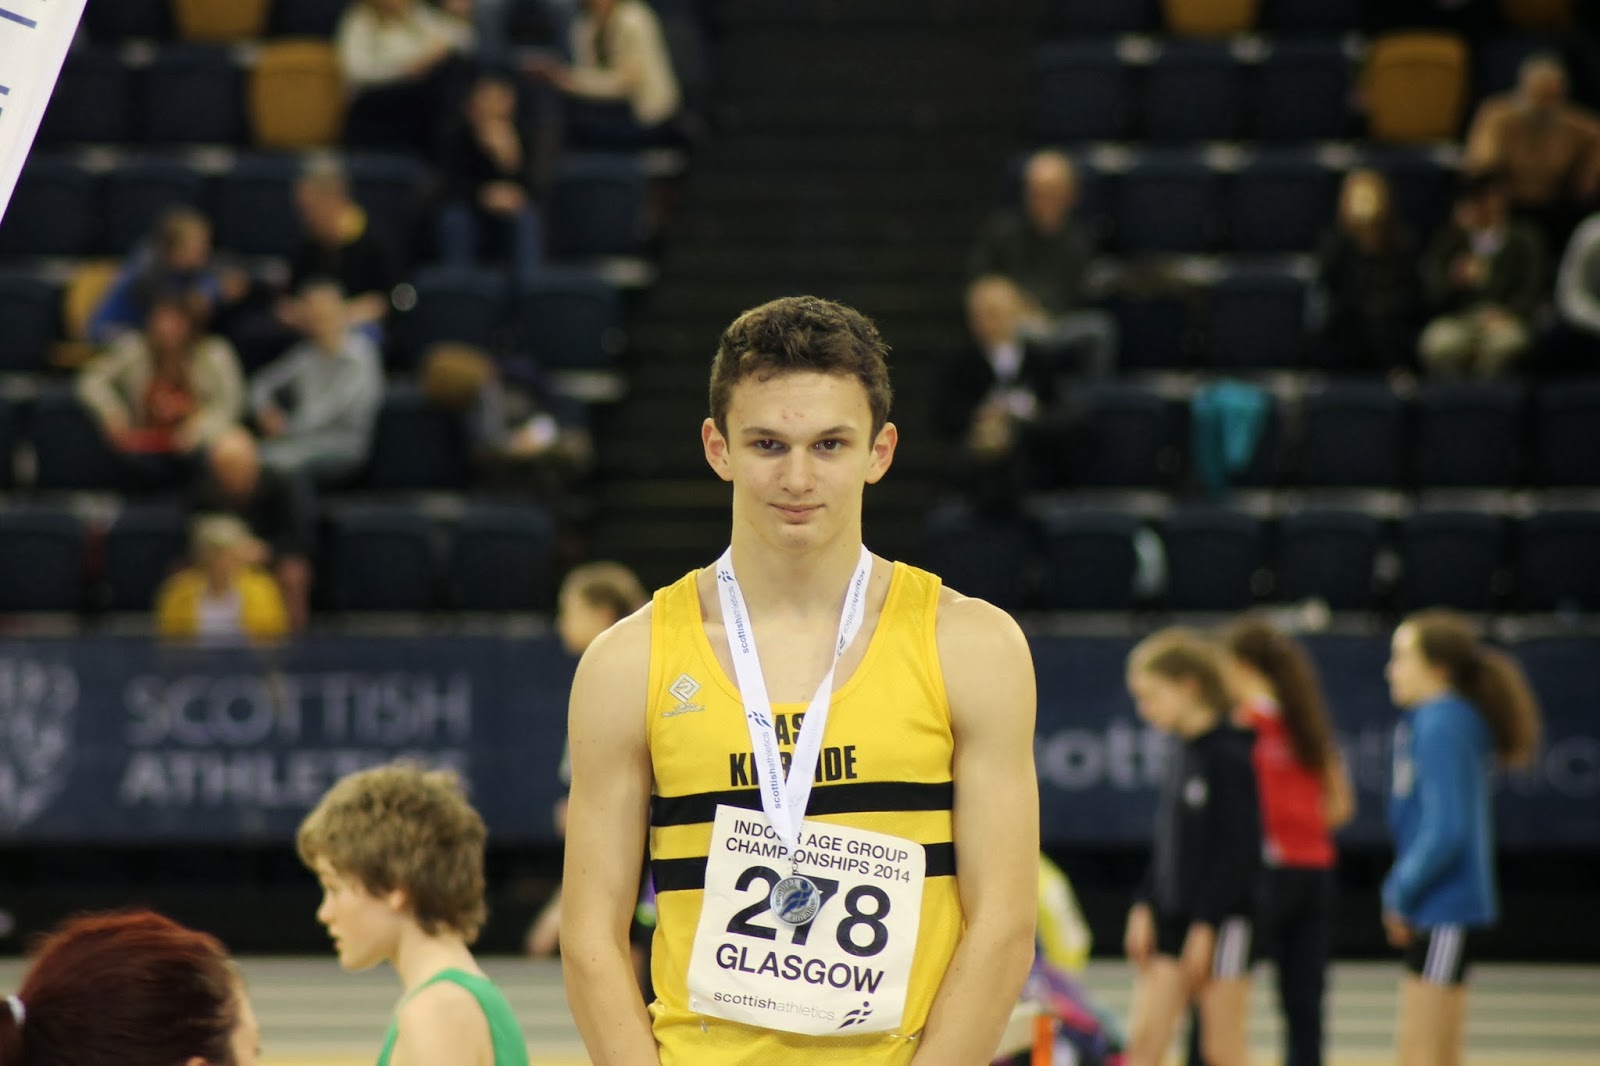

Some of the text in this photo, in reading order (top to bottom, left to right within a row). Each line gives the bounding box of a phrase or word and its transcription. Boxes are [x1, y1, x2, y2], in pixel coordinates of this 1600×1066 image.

[762, 731, 782, 809] scottishathletics
[726, 836, 911, 884] CHAMPONSHIPS 2014
[806, 833, 843, 852] AGE
[846, 840, 908, 864] GROUP
[725, 865, 891, 957] 278
[715, 943, 884, 995] GLASGOW
[713, 990, 835, 1021] scottishathletics
